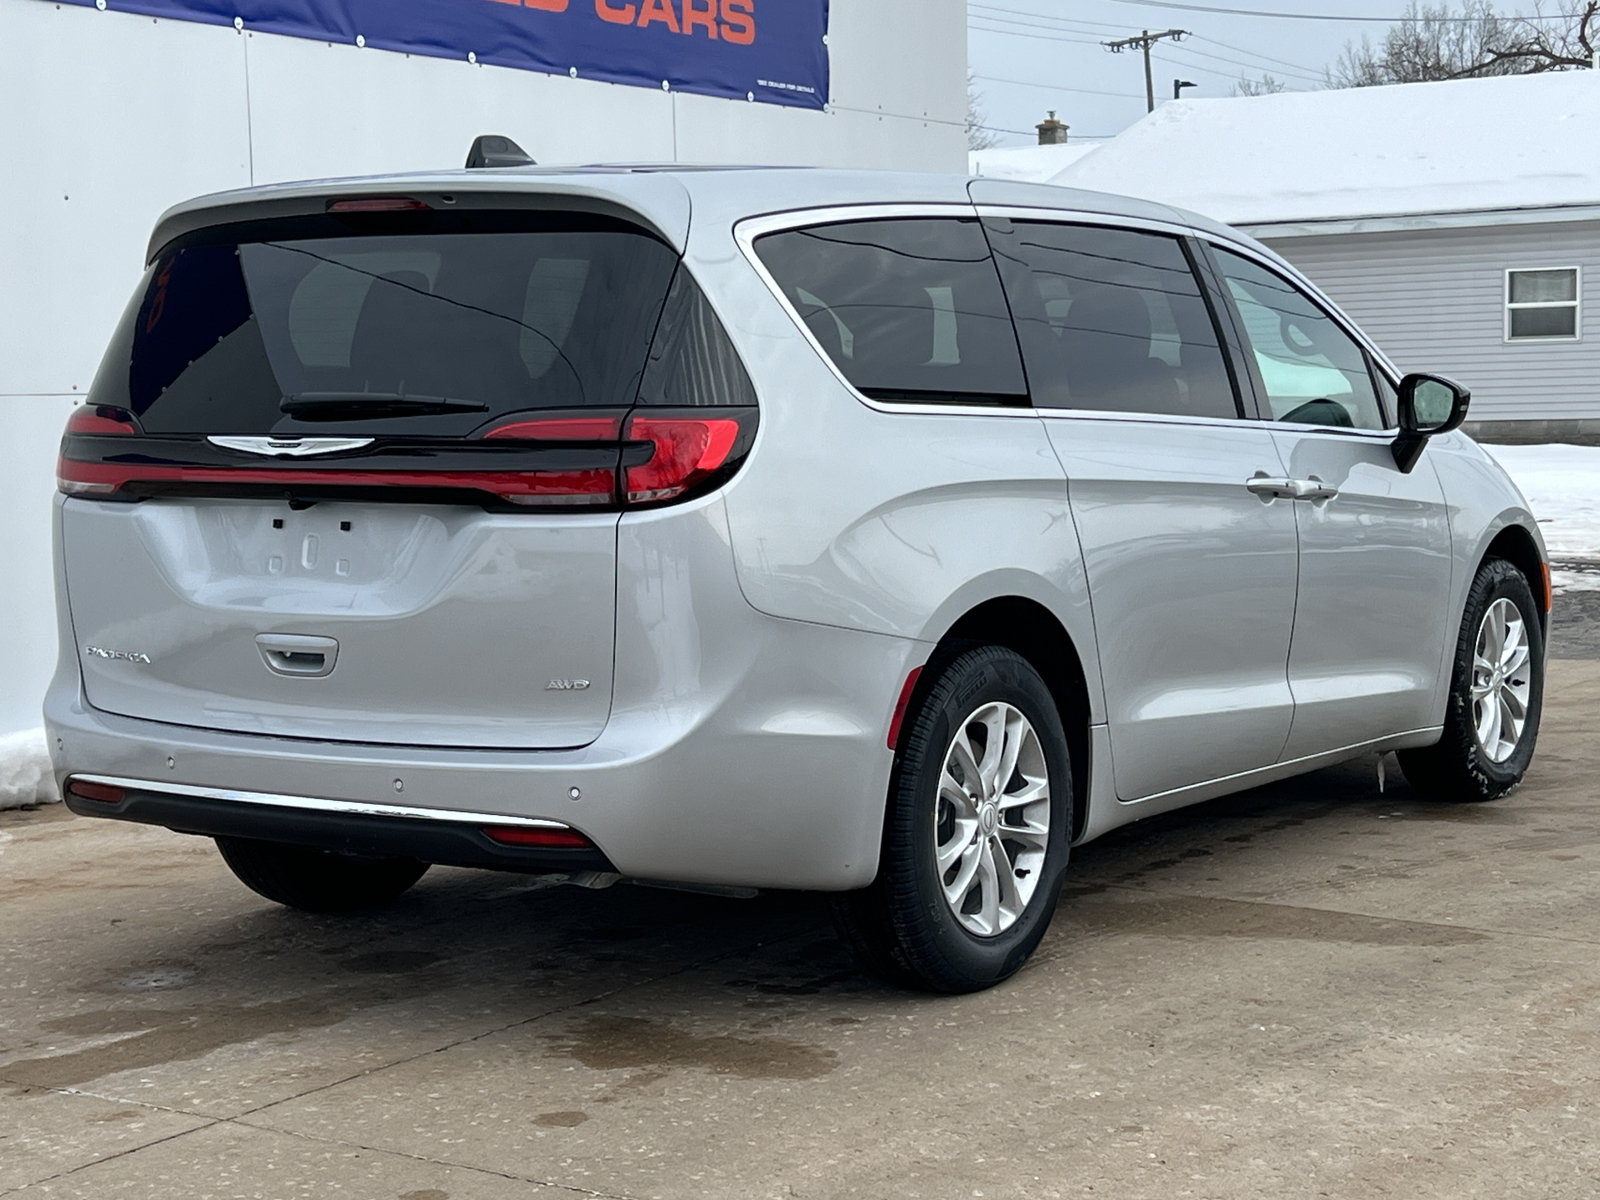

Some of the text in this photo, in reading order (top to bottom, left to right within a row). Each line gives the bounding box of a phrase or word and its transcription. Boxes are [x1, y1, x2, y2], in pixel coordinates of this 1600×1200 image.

[595, 0, 756, 45] CARS
[545, 679, 590, 690] AWD
[955, 671, 988, 710] PIRELLI
